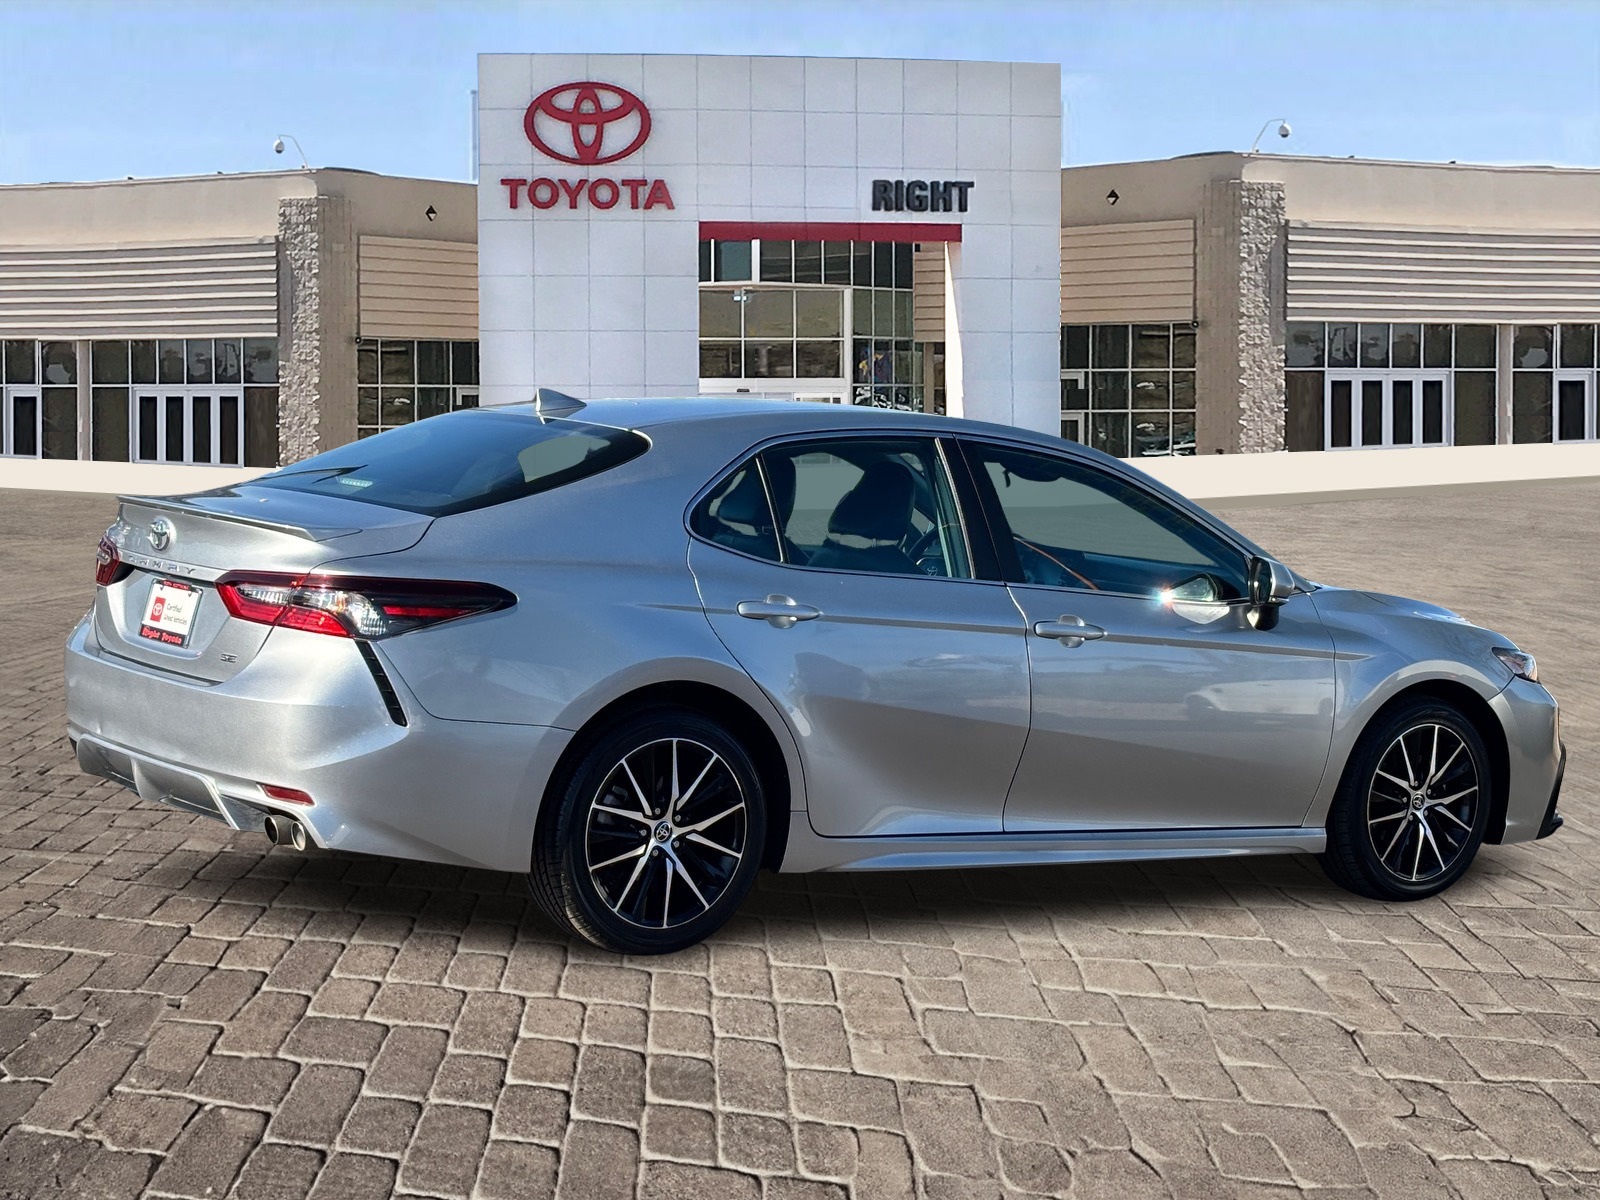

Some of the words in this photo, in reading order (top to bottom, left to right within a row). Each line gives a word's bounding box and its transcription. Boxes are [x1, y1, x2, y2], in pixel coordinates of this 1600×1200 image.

[500, 177, 675, 210] TOYOTA
[872, 179, 975, 213] RIGHT
[128, 555, 197, 575] CAMRY
[142, 626, 160, 639] Right
[161, 632, 182, 644] Toyota
